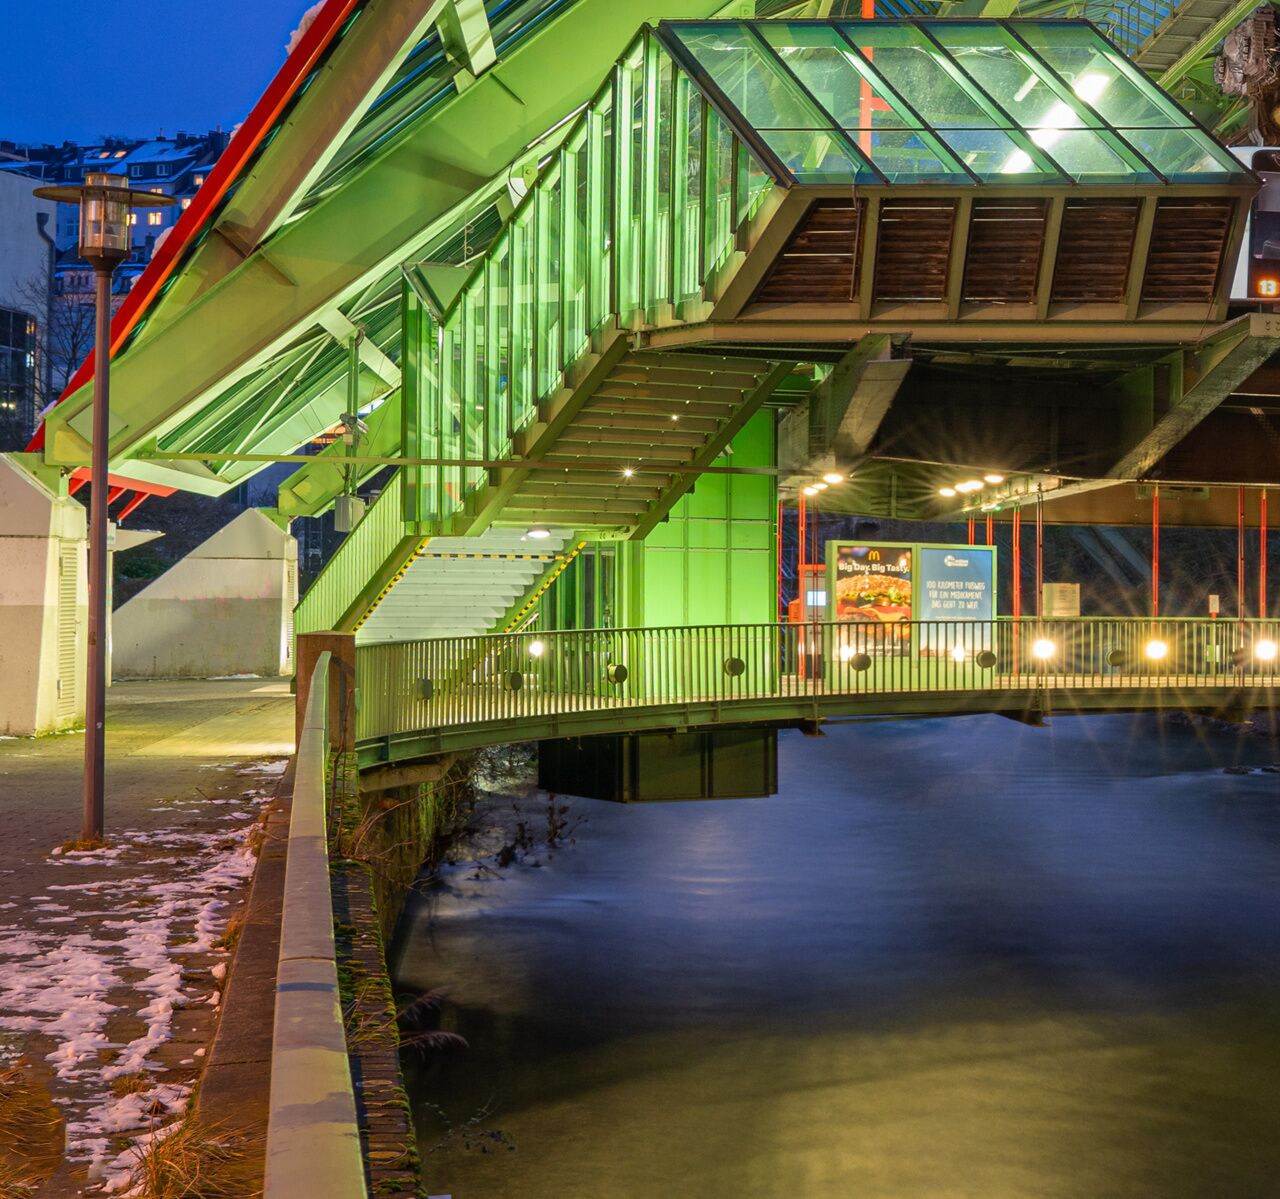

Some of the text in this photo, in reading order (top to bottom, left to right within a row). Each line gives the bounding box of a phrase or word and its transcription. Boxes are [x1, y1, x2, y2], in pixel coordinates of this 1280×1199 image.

[1259, 280, 1279, 295] 13
[839, 562, 910, 574] Big Day. Big Tasty.
[939, 591, 949, 599] EIN
